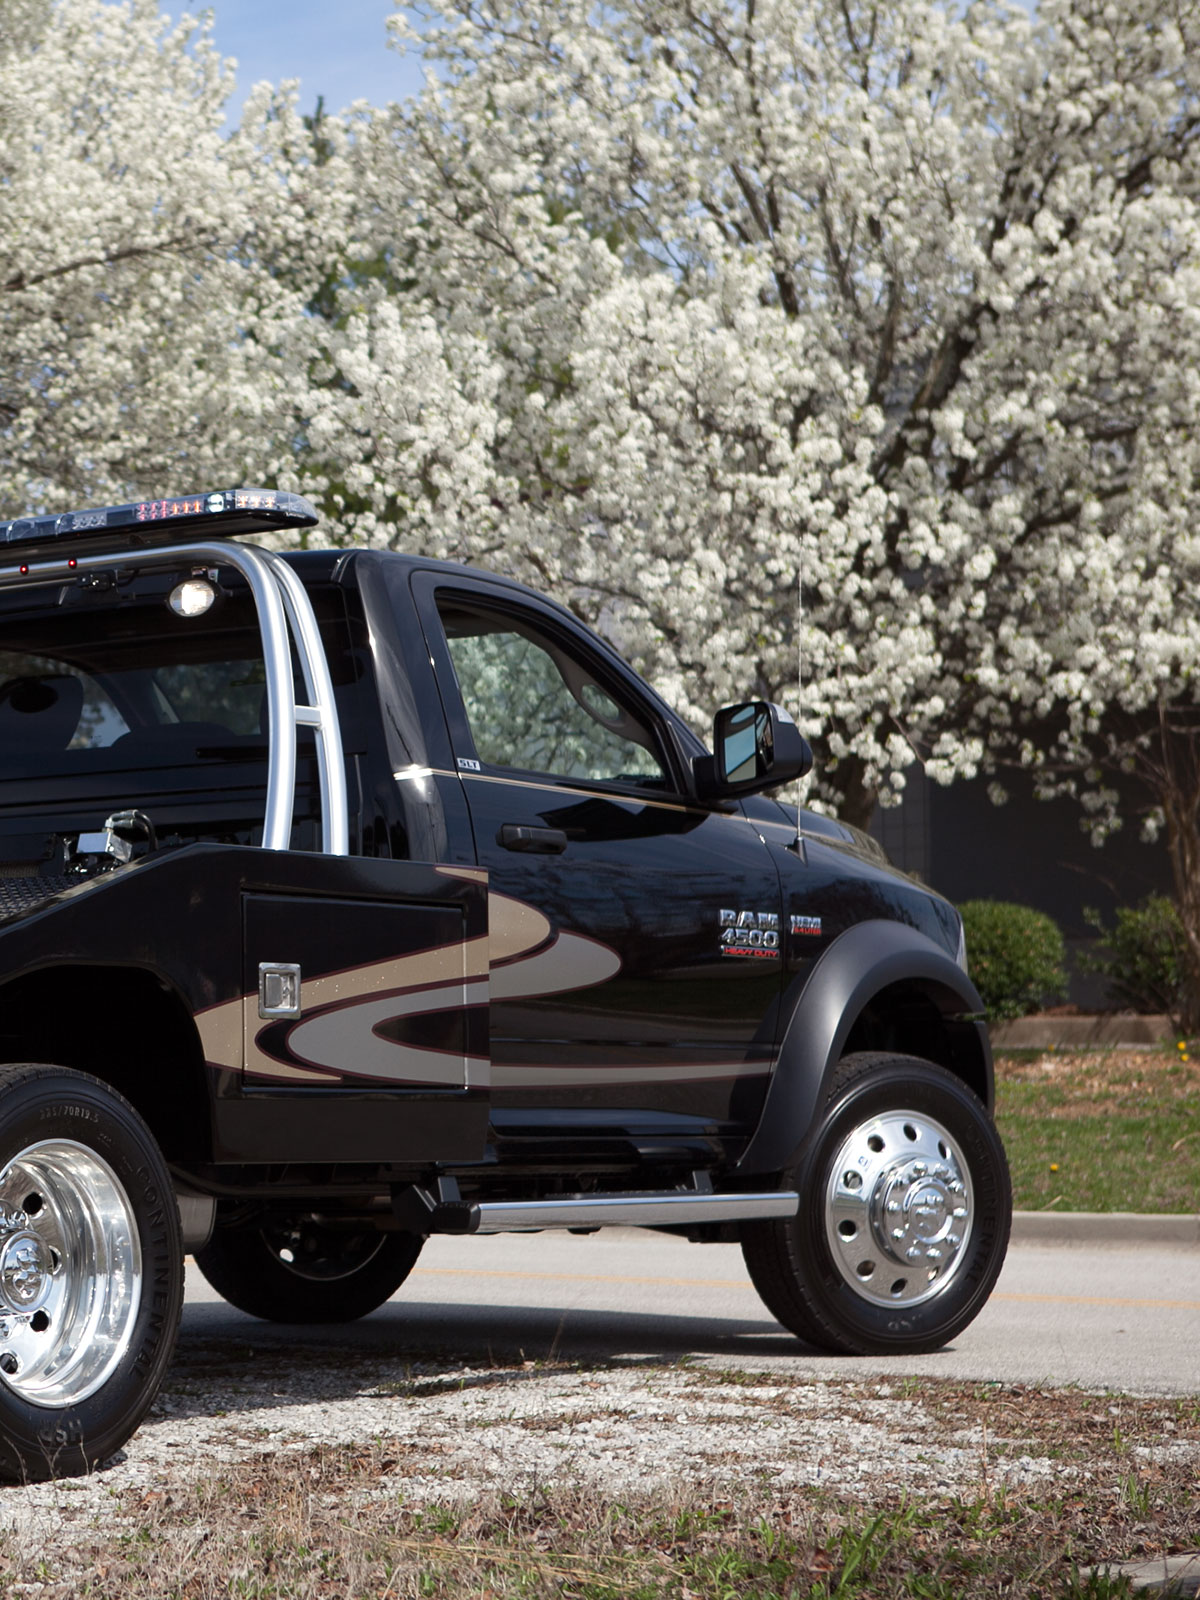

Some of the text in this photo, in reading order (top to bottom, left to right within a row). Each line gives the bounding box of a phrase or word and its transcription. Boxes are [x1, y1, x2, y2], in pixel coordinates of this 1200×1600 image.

[459, 759, 478, 770] SLT
[719, 909, 779, 930] RAM
[790, 914, 821, 929] HEMI
[720, 928, 780, 948] 4500
[724, 946, 778, 958] HEAVY DUTY
[129, 1166, 170, 1377] CONTINENTAL
